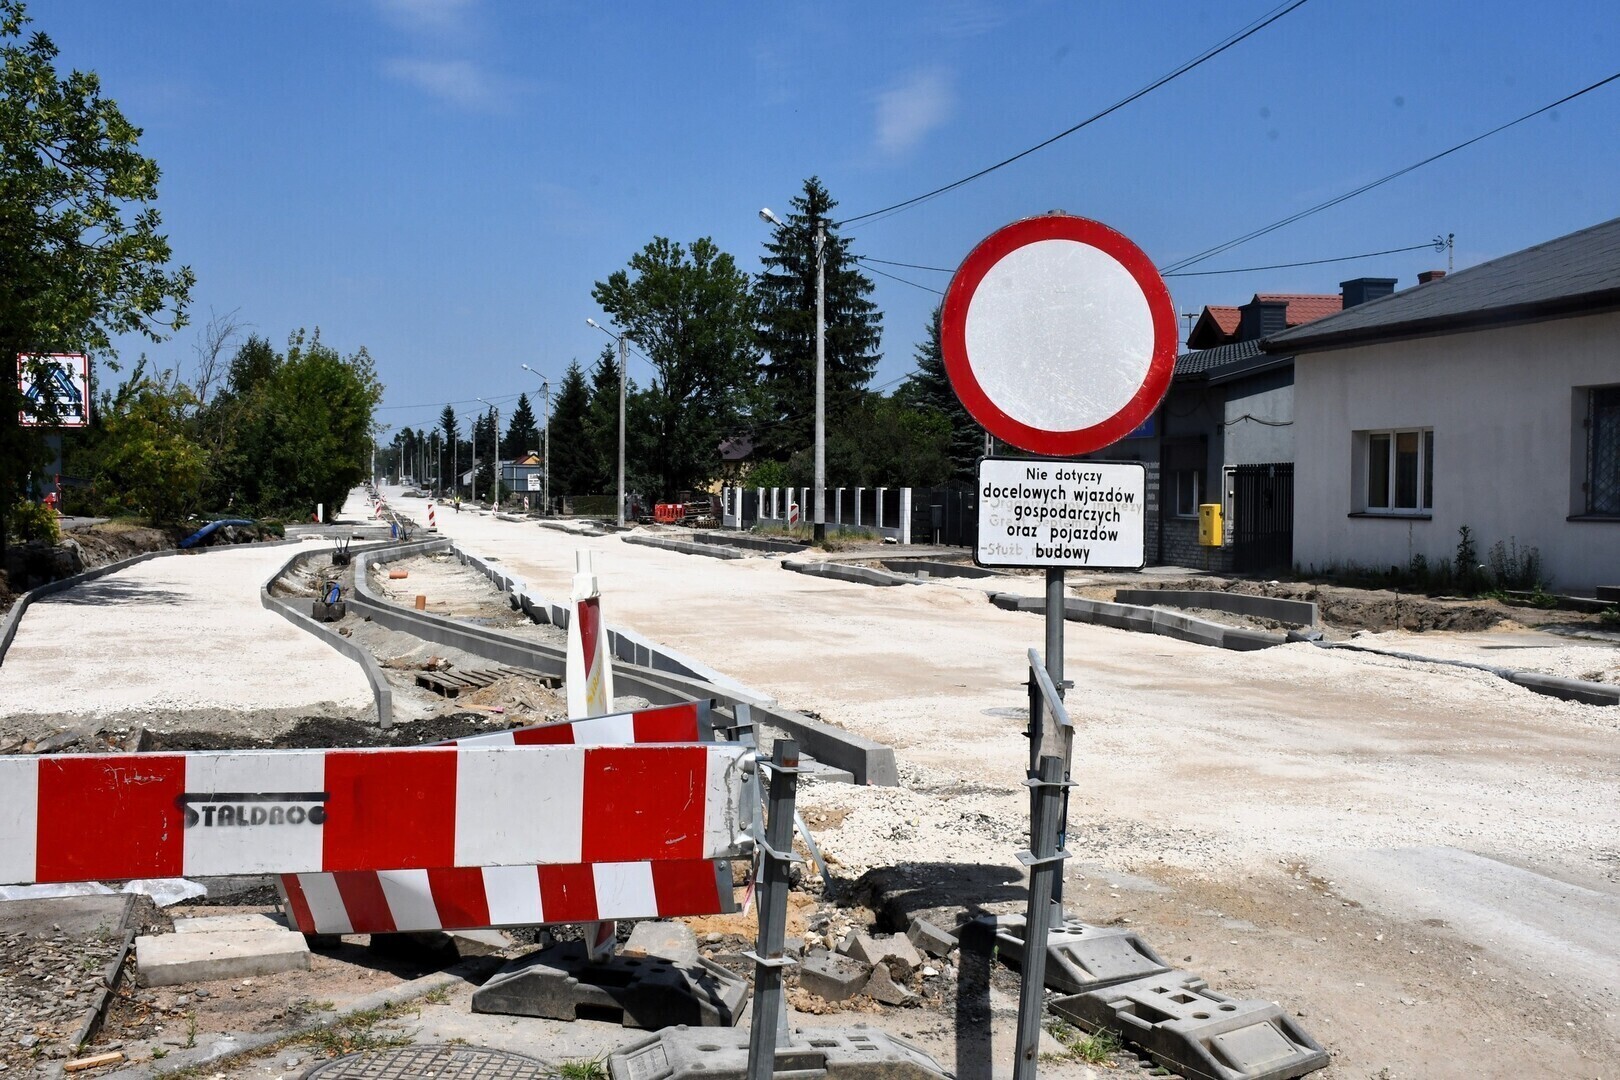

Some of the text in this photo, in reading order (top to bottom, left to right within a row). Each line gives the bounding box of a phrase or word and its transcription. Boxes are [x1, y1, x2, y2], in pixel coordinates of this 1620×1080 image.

[1026, 467, 1103, 485] Nie dotyczy
[983, 482, 1066, 504] docelowych
[1073, 486, 1135, 506] wjazdów
[1014, 504, 1120, 526] gospodarczych
[1007, 524, 1118, 542] oraz pojazdów
[1035, 542, 1090, 564] budowy
